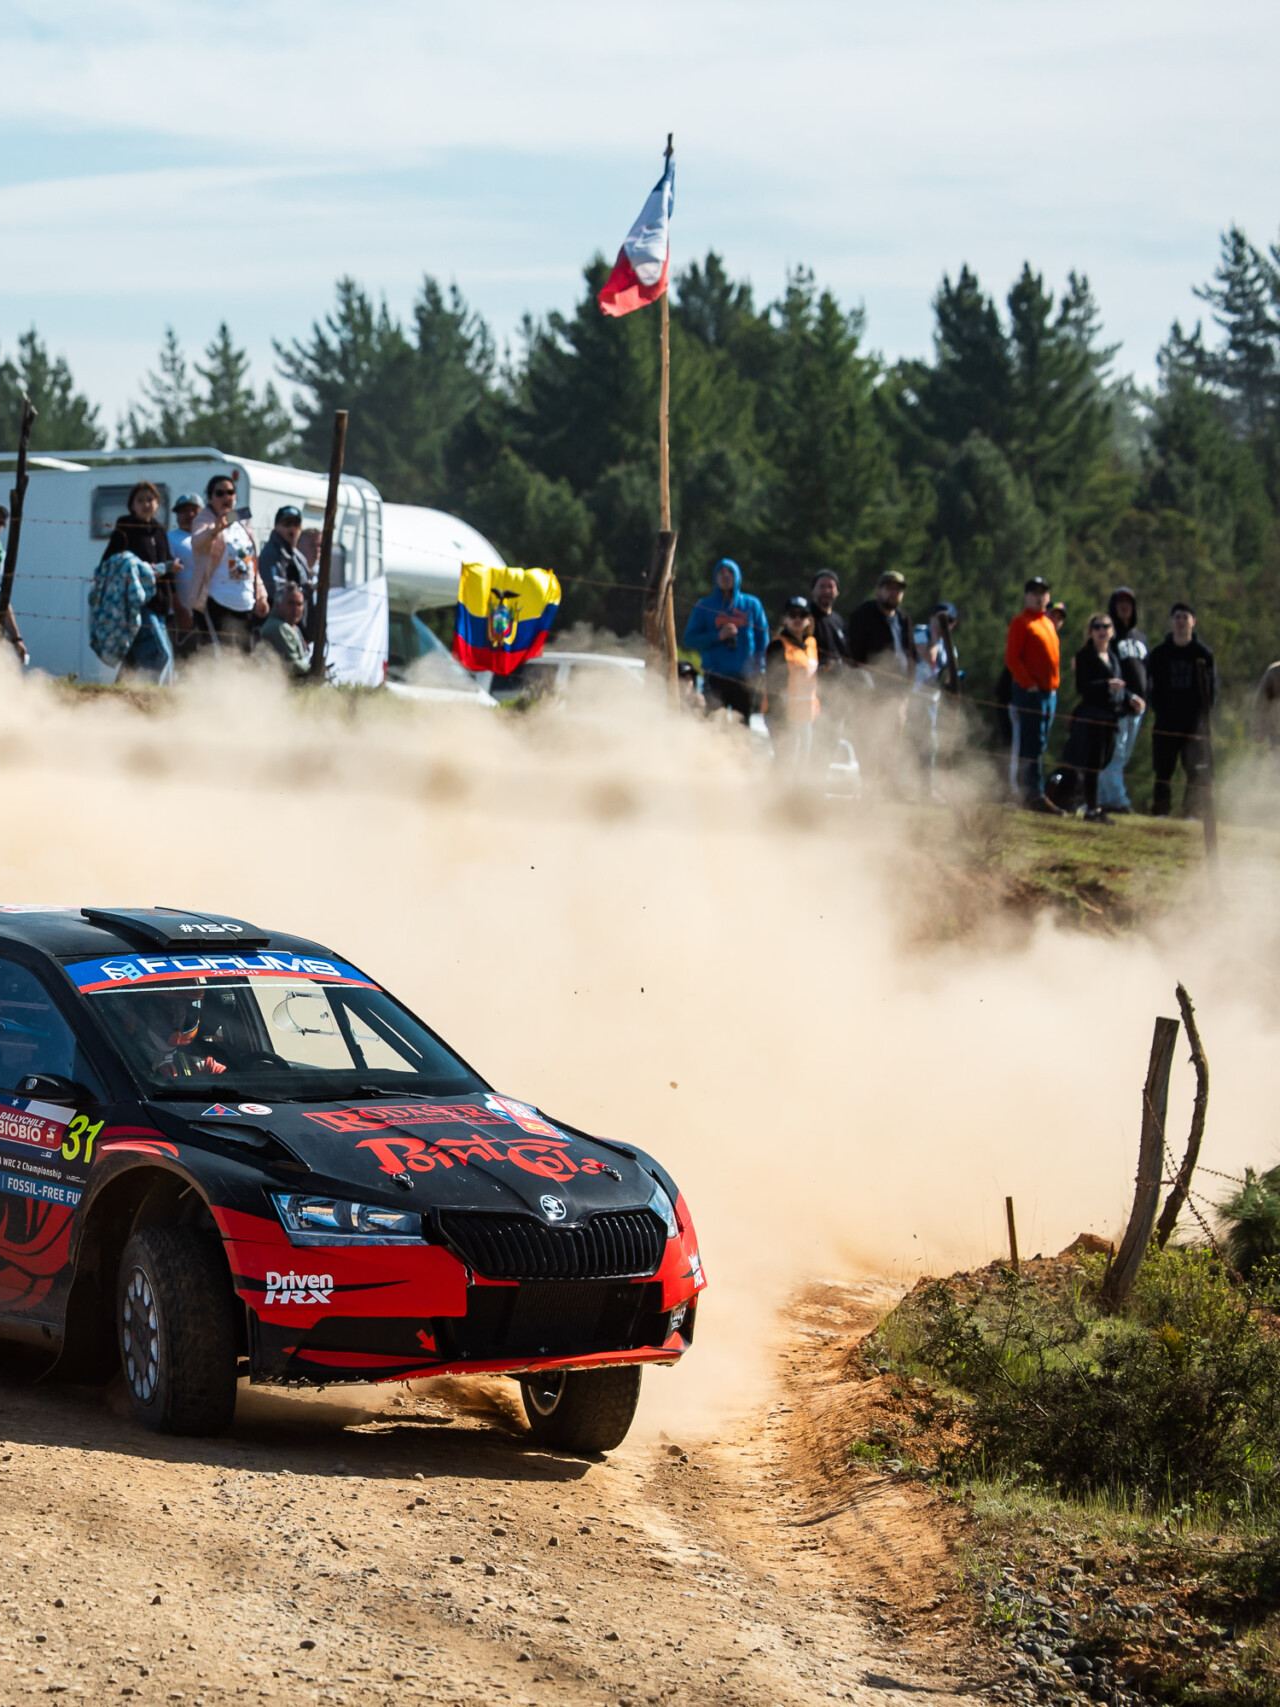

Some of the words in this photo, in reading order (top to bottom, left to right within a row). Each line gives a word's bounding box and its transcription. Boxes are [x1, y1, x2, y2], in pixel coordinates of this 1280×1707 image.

[179, 924, 243, 933] #150
[136, 954, 342, 977] FORUM8
[0, 1112, 46, 1128] RALLYCHILE
[62, 1115, 105, 1163] 31
[3, 1157, 16, 1169] WRC
[17, 1160, 21, 1169] 2
[22, 1161, 62, 1180] Championship
[355, 1134, 507, 1175] Point
[507, 1140, 606, 1182] Cola
[7, 1177, 65, 1201] FOSSIL-FREE
[266, 1270, 334, 1290] Driven
[264, 1289, 334, 1304] HRX
